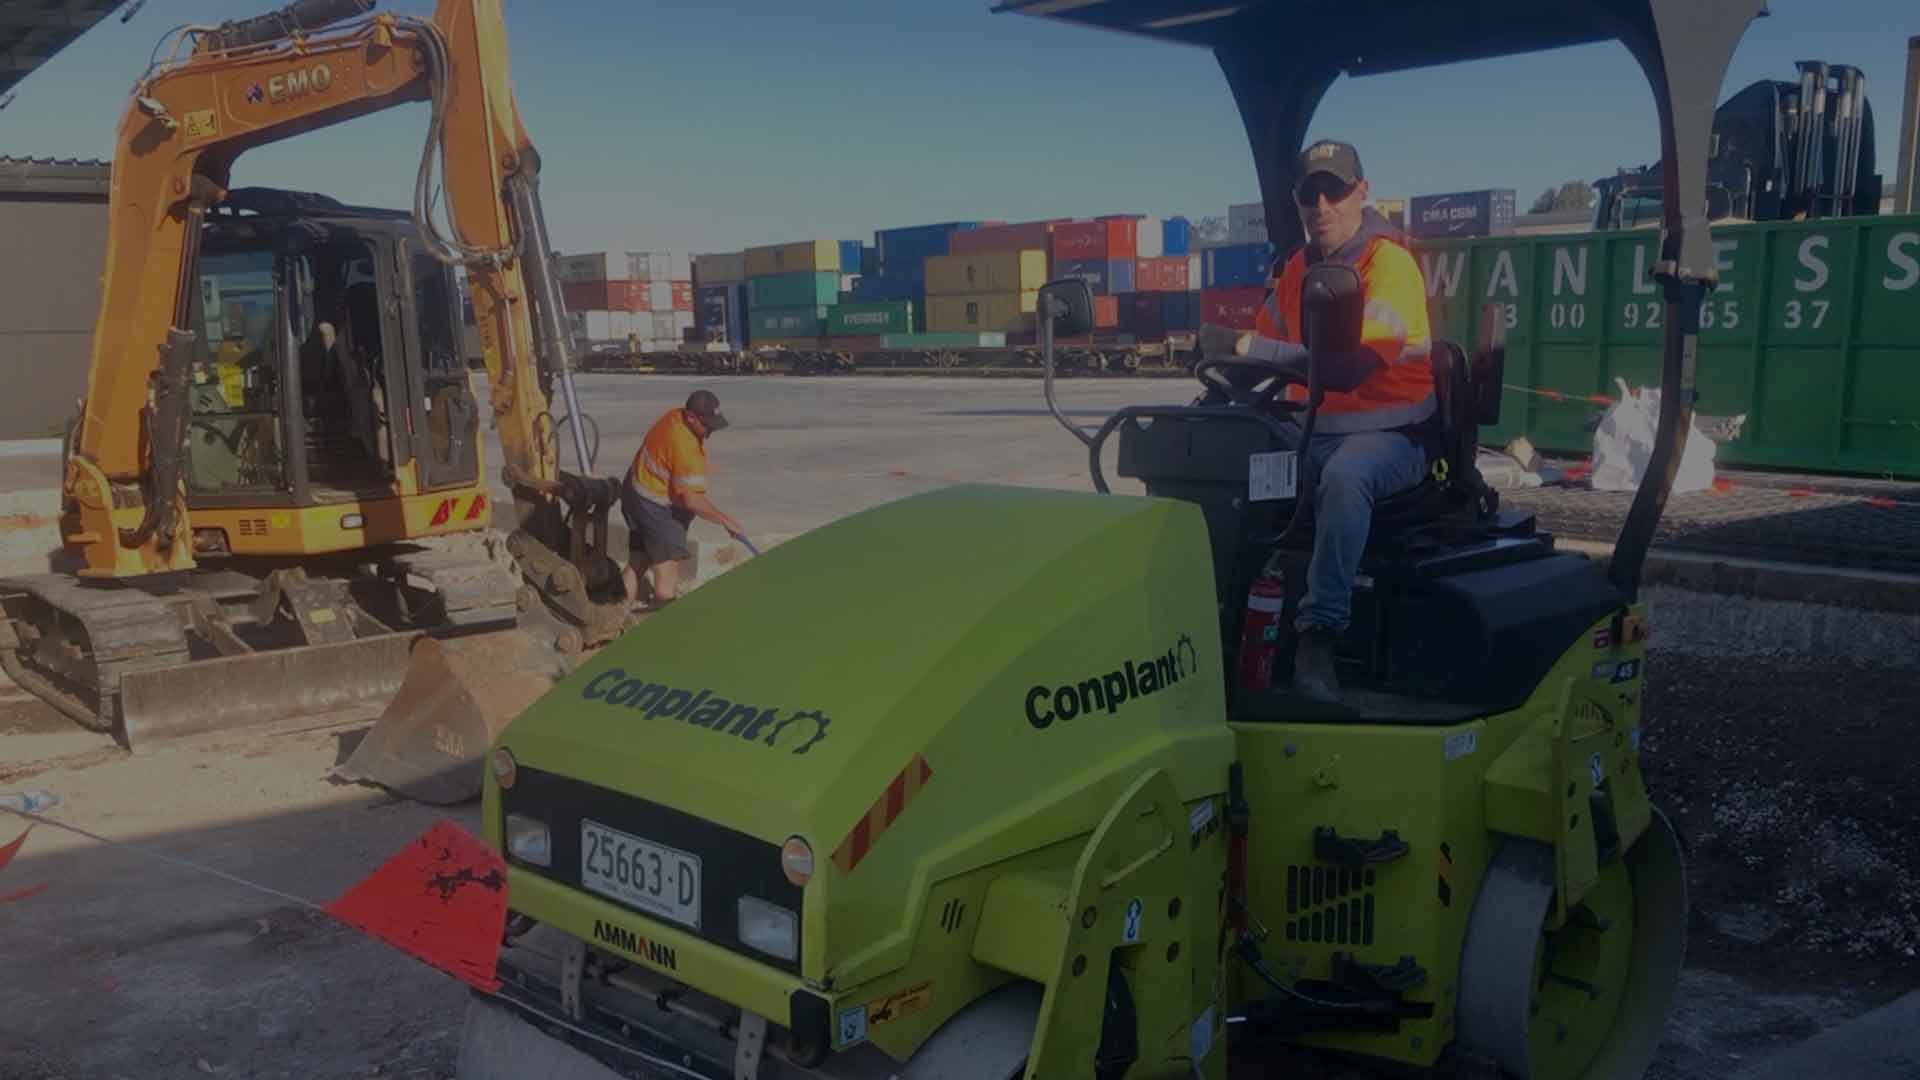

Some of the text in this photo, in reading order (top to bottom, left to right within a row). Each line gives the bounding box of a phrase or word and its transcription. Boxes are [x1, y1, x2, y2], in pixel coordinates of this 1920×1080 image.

[269, 64, 331, 98] EMO
[1550, 302, 1585, 329] 00
[1623, 302, 1661, 328] 92
[1783, 300, 1830, 329] 37
[582, 669, 778, 741] Conplant
[1025, 647, 1178, 729] Conplant
[594, 919, 676, 970] AMMANN
